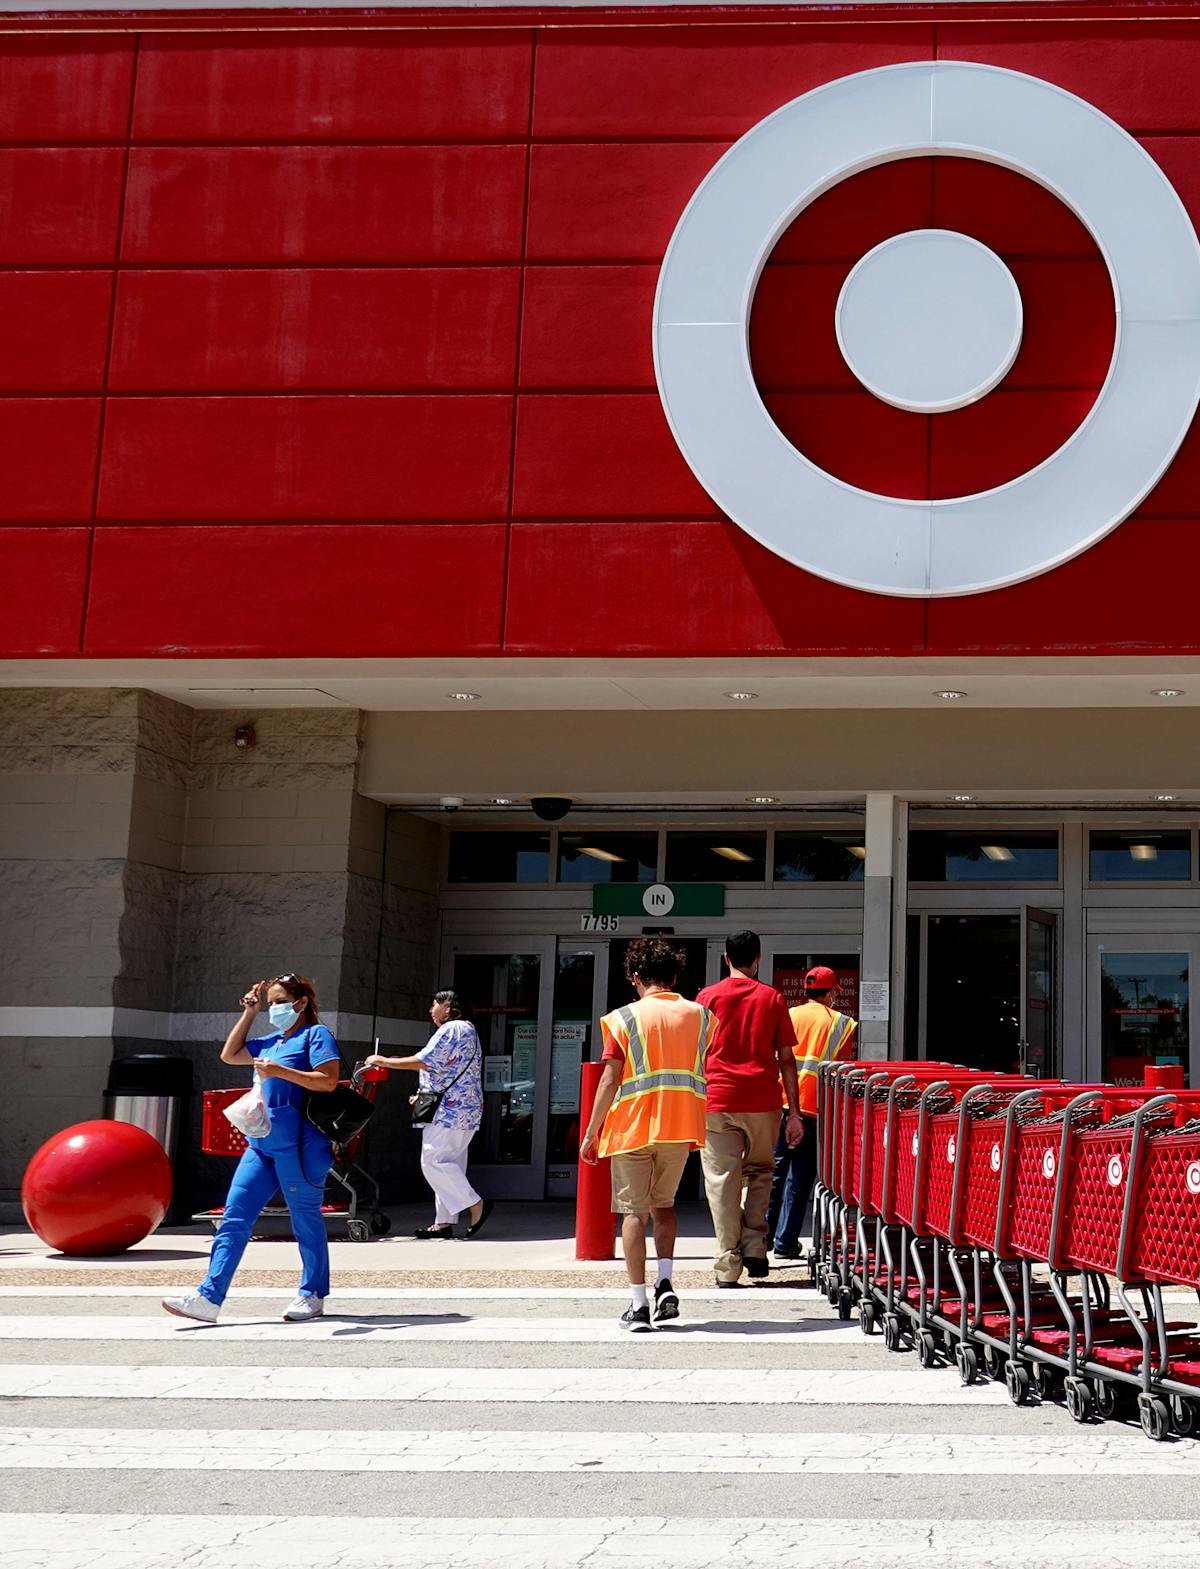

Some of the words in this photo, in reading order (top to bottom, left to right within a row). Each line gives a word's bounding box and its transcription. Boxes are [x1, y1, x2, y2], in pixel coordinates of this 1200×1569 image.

[651, 894, 666, 905] IN
[583, 915, 618, 930] 7795
[840, 978, 854, 986] FOR
[782, 989, 798, 997] ANY
[1114, 1077, 1145, 1088] We're
